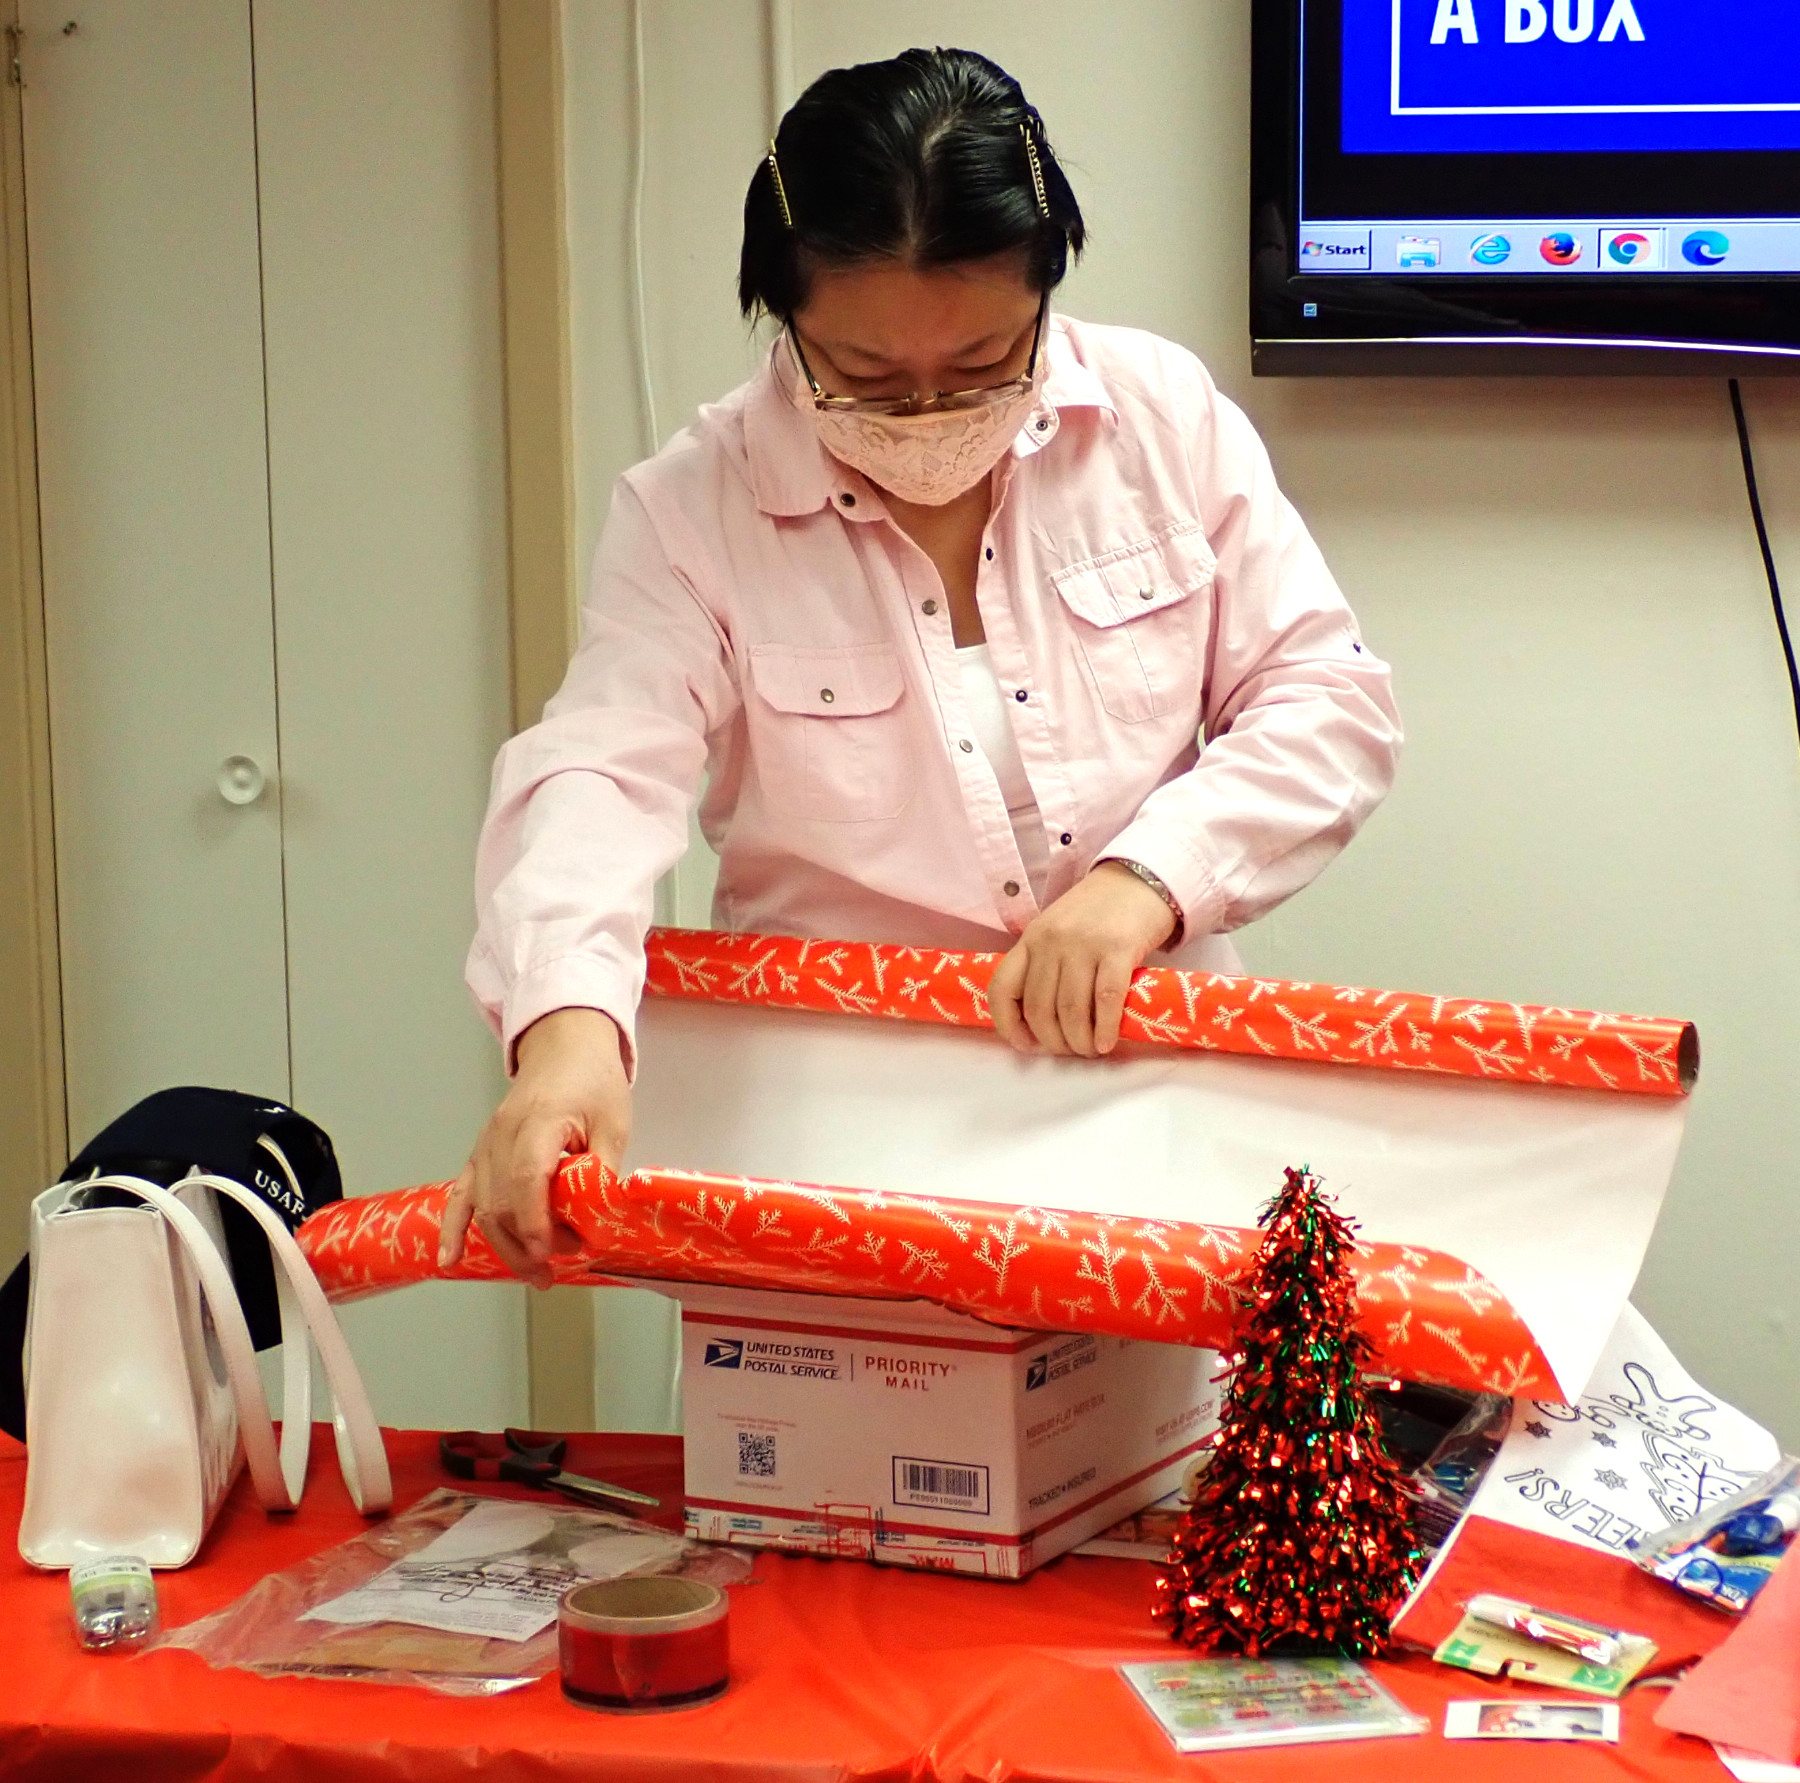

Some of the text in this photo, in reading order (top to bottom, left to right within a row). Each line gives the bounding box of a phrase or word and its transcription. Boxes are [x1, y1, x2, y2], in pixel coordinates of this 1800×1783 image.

[1429, 0, 1479, 44] A
[1325, 243, 1367, 257] Start
[746, 1341, 835, 1361] UNITED STATES
[744, 1360, 839, 1380] POSTAL SERVICE
[865, 1355, 950, 1377] PRIORITY
[885, 1376, 929, 1392] MAIL
[1504, 1468, 1650, 1550] EERS!
